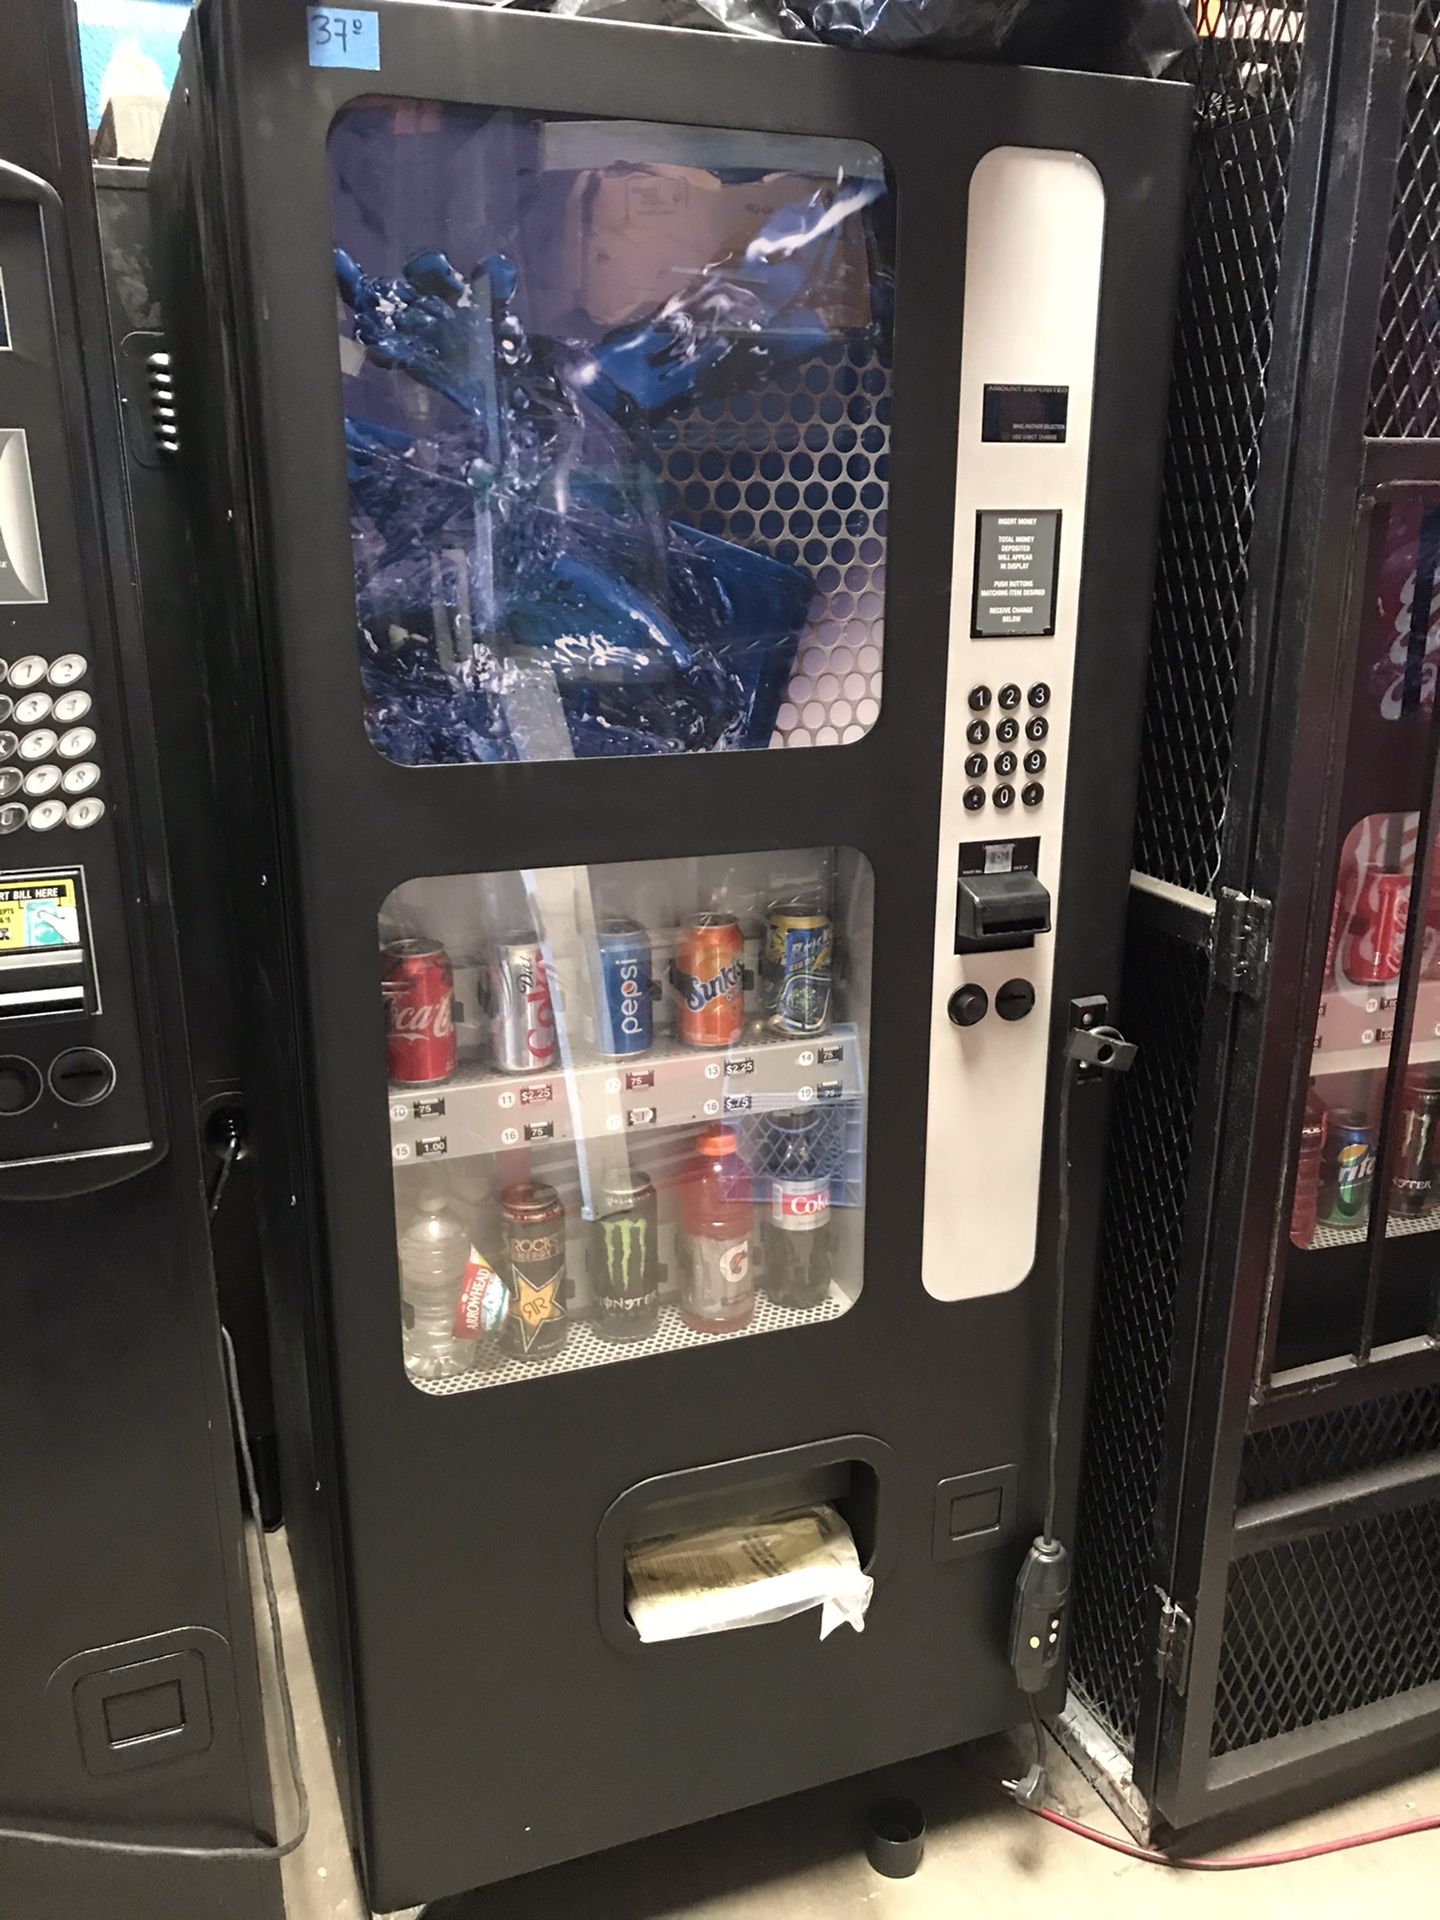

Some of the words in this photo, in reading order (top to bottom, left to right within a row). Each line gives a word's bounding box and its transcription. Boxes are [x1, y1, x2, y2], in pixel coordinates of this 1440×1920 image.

[1001, 544, 1031, 552] DEPOSITED
[1000, 562, 1007, 570] IN
[1007, 562, 1030, 570] DISPLAY
[1009, 580, 1034, 588] BUTTONS
[980, 589, 1008, 597] MATCHING
[1023, 588, 1046, 596] DESIRED
[1011, 606, 1034, 614] CHANGE
[1002, 615, 1022, 623] BELOW
[976, 690, 984, 707] 1
[1006, 689, 1015, 705] 2
[1035, 687, 1046, 703] 3
[973, 724, 983, 740] 4
[1003, 722, 1014, 739] 5
[1032, 720, 1043, 737] 6
[973, 757, 982, 774] 7
[1001, 755, 1012, 771] 8
[1030, 753, 1041, 770] 9
[1000, 788, 1009, 804] 0
[13, 889, 32, 900] BILL
[35, 887, 59, 898] HERE
[615, 958, 643, 1034] pepsi
[823, 1052, 834, 1060] 75
[726, 1062, 753, 1074] $2.25
[630, 1077, 642, 1085] 75
[521, 1088, 551, 1101] $2.25
[726, 1097, 749, 1109] $.75
[419, 1105, 432, 1113] 75
[531, 1128, 544, 1136] 75
[424, 1141, 445, 1151] 1.00
[466, 1268, 490, 1330] ARROWHEAD
